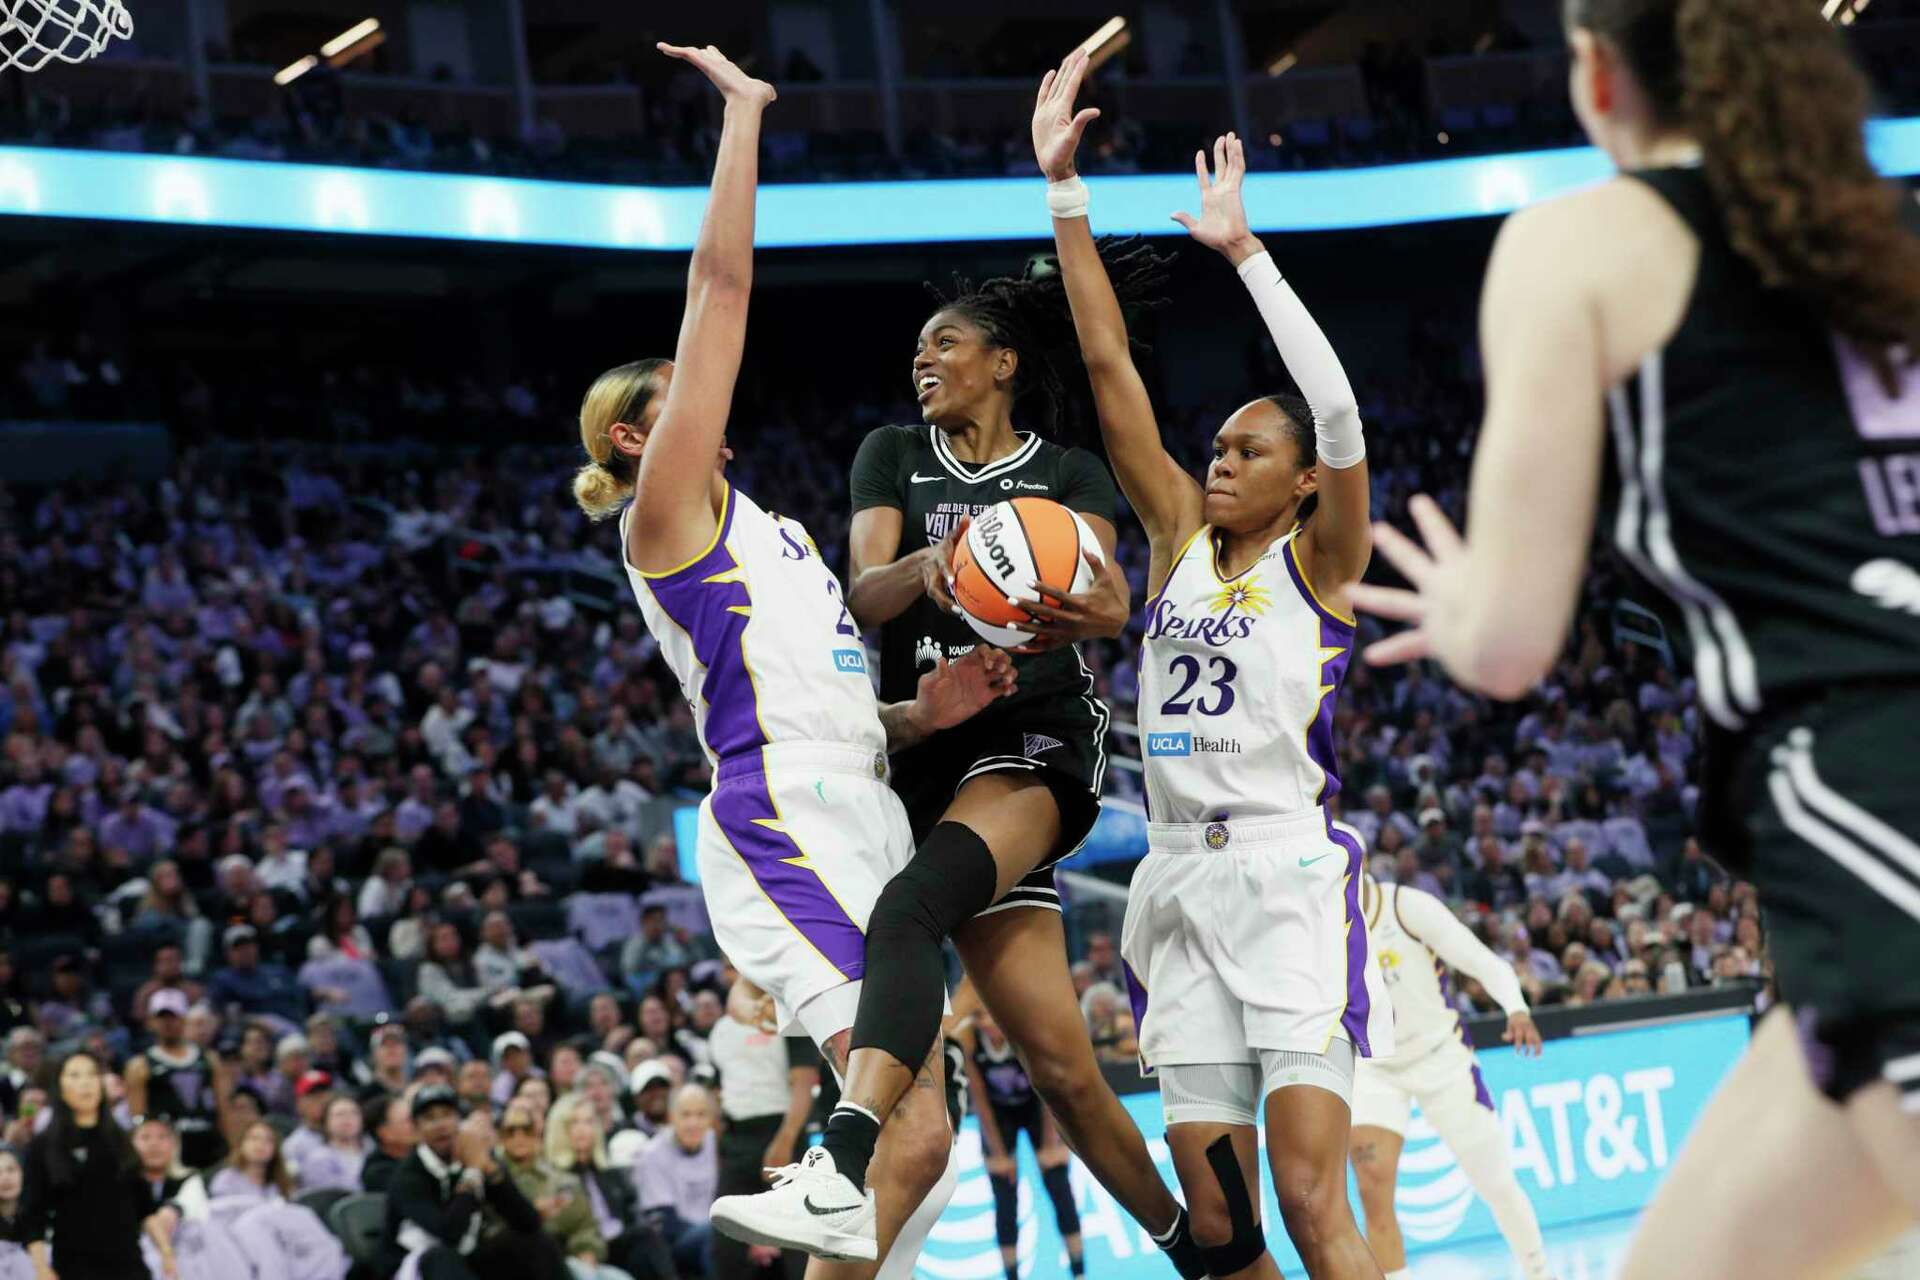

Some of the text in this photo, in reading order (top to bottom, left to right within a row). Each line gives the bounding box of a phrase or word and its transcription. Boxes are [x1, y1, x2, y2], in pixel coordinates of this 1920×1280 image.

[936, 503, 970, 514] GOLDEN
[1147, 600, 1255, 647] SPARKS
[1160, 655, 1238, 716] 23
[1151, 737, 1241, 754] UCLA Health
[1502, 1066, 1675, 1189] AT&T
